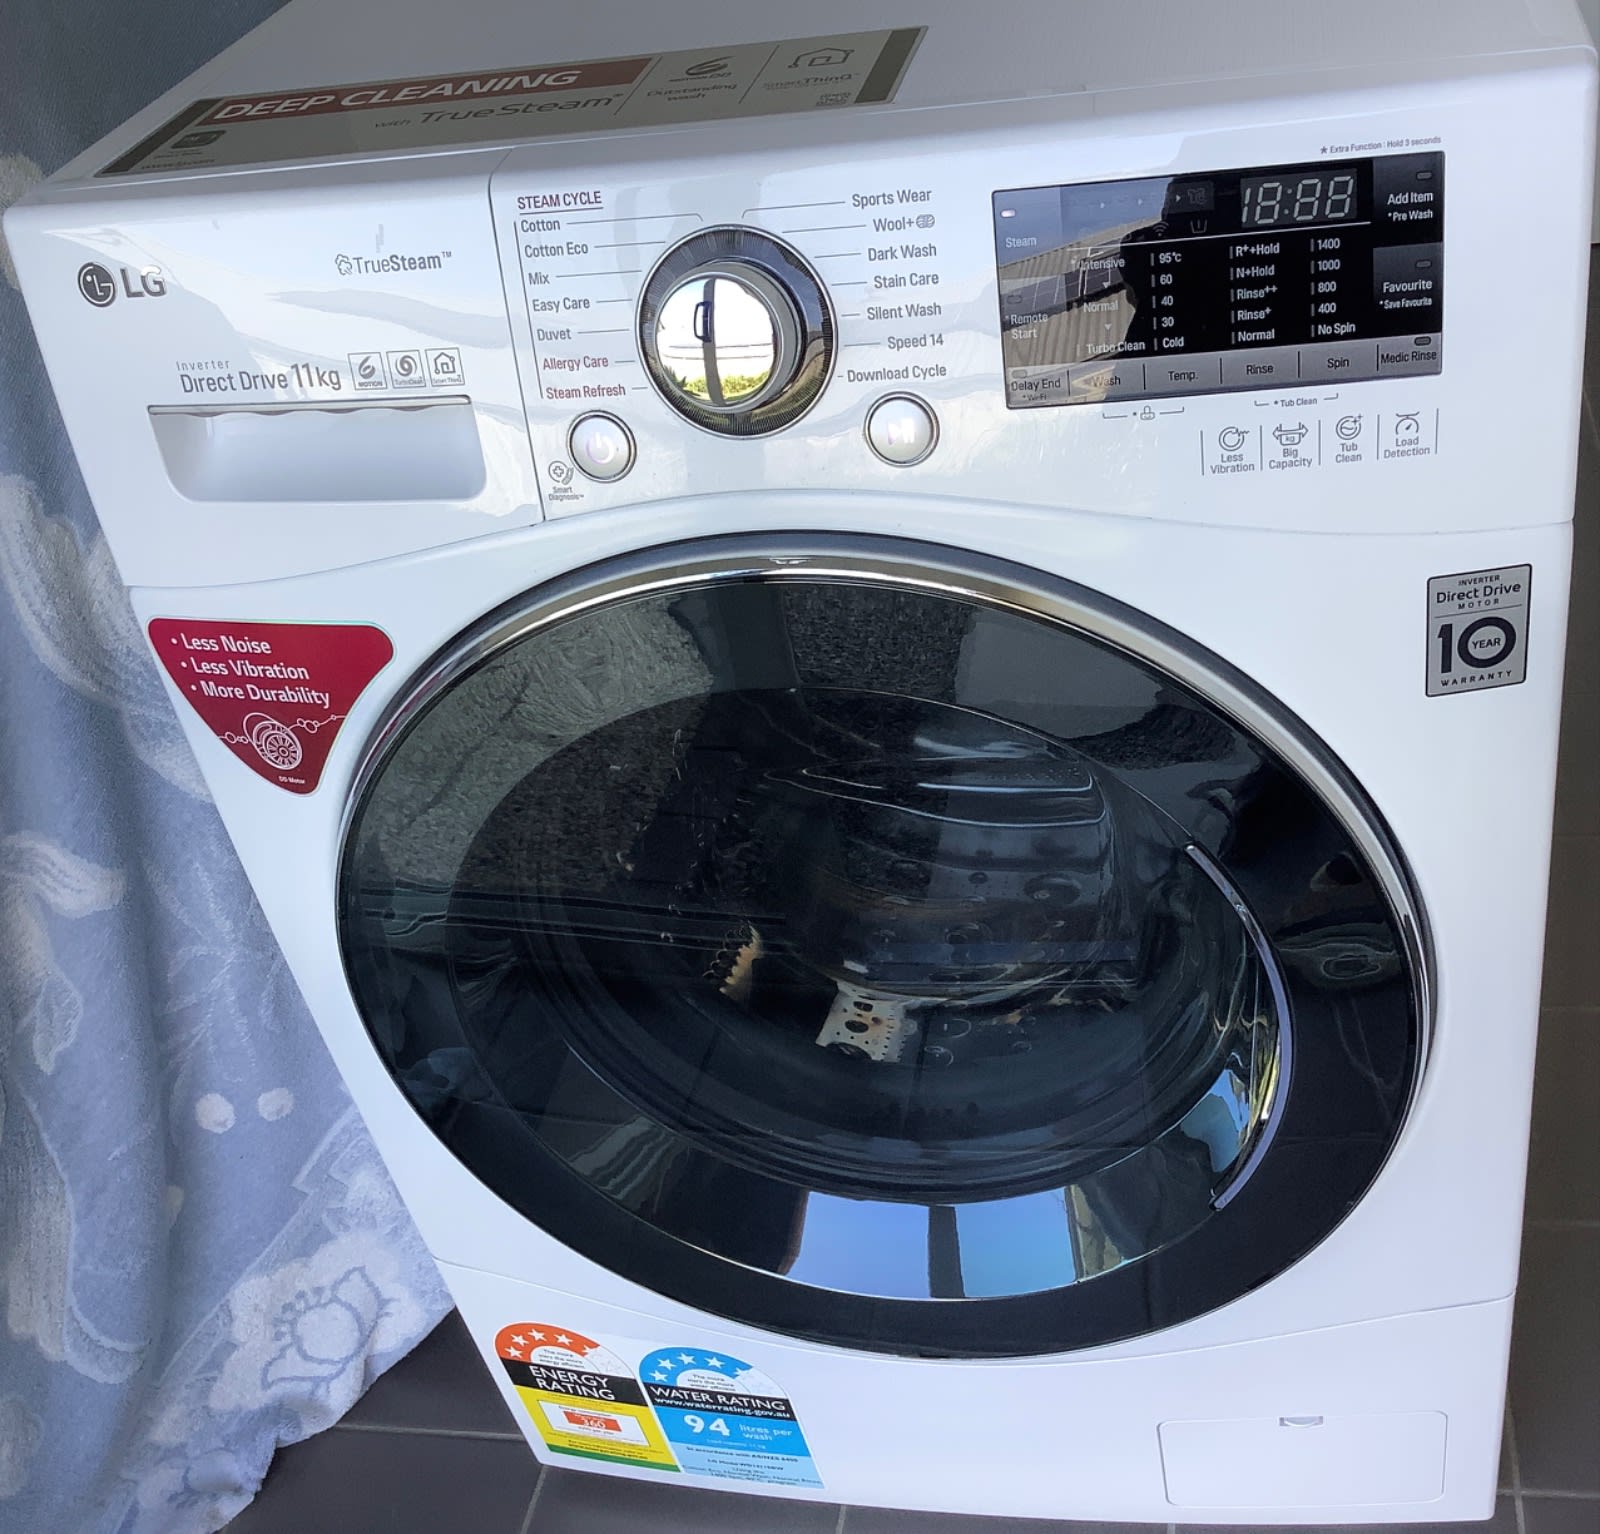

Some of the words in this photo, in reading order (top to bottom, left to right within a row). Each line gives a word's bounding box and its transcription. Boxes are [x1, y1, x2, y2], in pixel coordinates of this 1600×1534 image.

[214, 94, 339, 119] DEEP
[340, 70, 582, 106] CLEANING
[647, 84, 737, 97] Outstanding
[374, 119, 411, 129] with
[1330, 145, 1349, 153] Extra
[1351, 142, 1382, 152] Function
[1387, 139, 1404, 148] Hold
[1411, 136, 1442, 145] seconds
[517, 194, 560, 209] STEAM
[563, 191, 602, 206] CYCLE
[852, 192, 894, 209] Sports
[897, 189, 932, 202] Wear
[1387, 193, 1408, 205] Add
[1410, 191, 1433, 203] Item
[1392, 211, 1407, 222] Pre
[1408, 209, 1433, 220] Wash
[521, 218, 560, 233] Cotton
[1005, 237, 1037, 248] Steam
[1317, 238, 1341, 250] 1400
[525, 244, 564, 258] Cotton
[566, 242, 589, 255] Eco
[868, 246, 898, 261] Dark
[900, 243, 937, 258] Wash
[1236, 265, 1275, 278] N+Hold
[1317, 260, 1341, 272] 1000
[119, 264, 168, 299] LG
[528, 271, 550, 285] Mix
[874, 275, 907, 289] Stain
[910, 273, 939, 286] Care
[1160, 273, 1173, 285] 60
[1318, 281, 1337, 293] 800
[1383, 280, 1433, 292] Favourite
[533, 299, 560, 313] Easy
[563, 297, 590, 310] Care
[1083, 300, 1119, 312] Normal
[1161, 295, 1174, 307] 40
[1384, 299, 1401, 309] Save
[1401, 297, 1433, 308] Favourite
[867, 306, 903, 320] Silent
[905, 303, 942, 317] Wash
[1237, 306, 1272, 321] Rinse+
[1318, 302, 1337, 314] 400
[1010, 313, 1048, 324] Remote
[1162, 316, 1175, 328] 30
[537, 328, 572, 341] Duvet
[1011, 328, 1037, 340] Start
[1318, 324, 1333, 335] No
[1334, 322, 1356, 335] Spin
[887, 334, 927, 351] Speed
[930, 333, 944, 346] 14
[1238, 329, 1275, 342] Normal
[1086, 342, 1115, 354] Turbo
[1117, 340, 1146, 352] Clean
[1162, 337, 1184, 348] Cold
[1381, 351, 1409, 363] Medic
[1411, 349, 1437, 362] Rinse
[176, 359, 230, 372] Inverter
[543, 357, 580, 371] Allergy
[583, 355, 609, 367] Care
[1246, 364, 1274, 375] Rinse
[1327, 357, 1350, 370] Spin
[180, 373, 236, 393] Direct
[240, 369, 289, 392] Drive
[291, 363, 342, 391] 11kg
[847, 367, 909, 382] Download
[912, 364, 947, 379] Cycle
[1168, 371, 1199, 382] Temp.
[1011, 381, 1039, 392] Delay
[1041, 378, 1061, 388] End
[1092, 375, 1121, 388] Wash
[546, 387, 581, 400] Steam
[583, 384, 626, 397] Refresh
[1280, 399, 1295, 408] Tub
[1296, 397, 1318, 407] Clean
[1340, 442, 1358, 452] Tub
[1395, 437, 1419, 448] Load
[1221, 453, 1244, 464] Less
[1282, 448, 1299, 460] Big
[1335, 453, 1362, 464] Clean
[1383, 447, 1430, 459] Detection
[1210, 463, 1255, 475] Vibration
[1268, 458, 1313, 470] Capacity
[1458, 575, 1500, 586] INVERTER
[1436, 588, 1479, 604] Direct
[1483, 583, 1521, 597] Drive
[1458, 598, 1499, 610] MOTOR
[180, 633, 219, 651] Less
[220, 636, 272, 654] Noise
[1437, 616, 1517, 674] 10
[1472, 637, 1501, 650] YEAR
[190, 657, 229, 676] Less
[229, 660, 310, 680] Vibration
[1440, 670, 1512, 687] WARRANTY
[200, 680, 244, 700] More
[246, 684, 330, 709] Durability
[529, 1365, 609, 1388] ENERGY
[535, 1378, 615, 1400] RATING
[650, 1386, 716, 1402] WATER
[717, 1394, 786, 1411] RATING
[655, 1397, 791, 1418] www.waterrating.gov.au
[684, 1414, 731, 1436] 94
[739, 1423, 770, 1434] litres
[773, 1427, 793, 1437] per
[743, 1432, 773, 1441] wash
